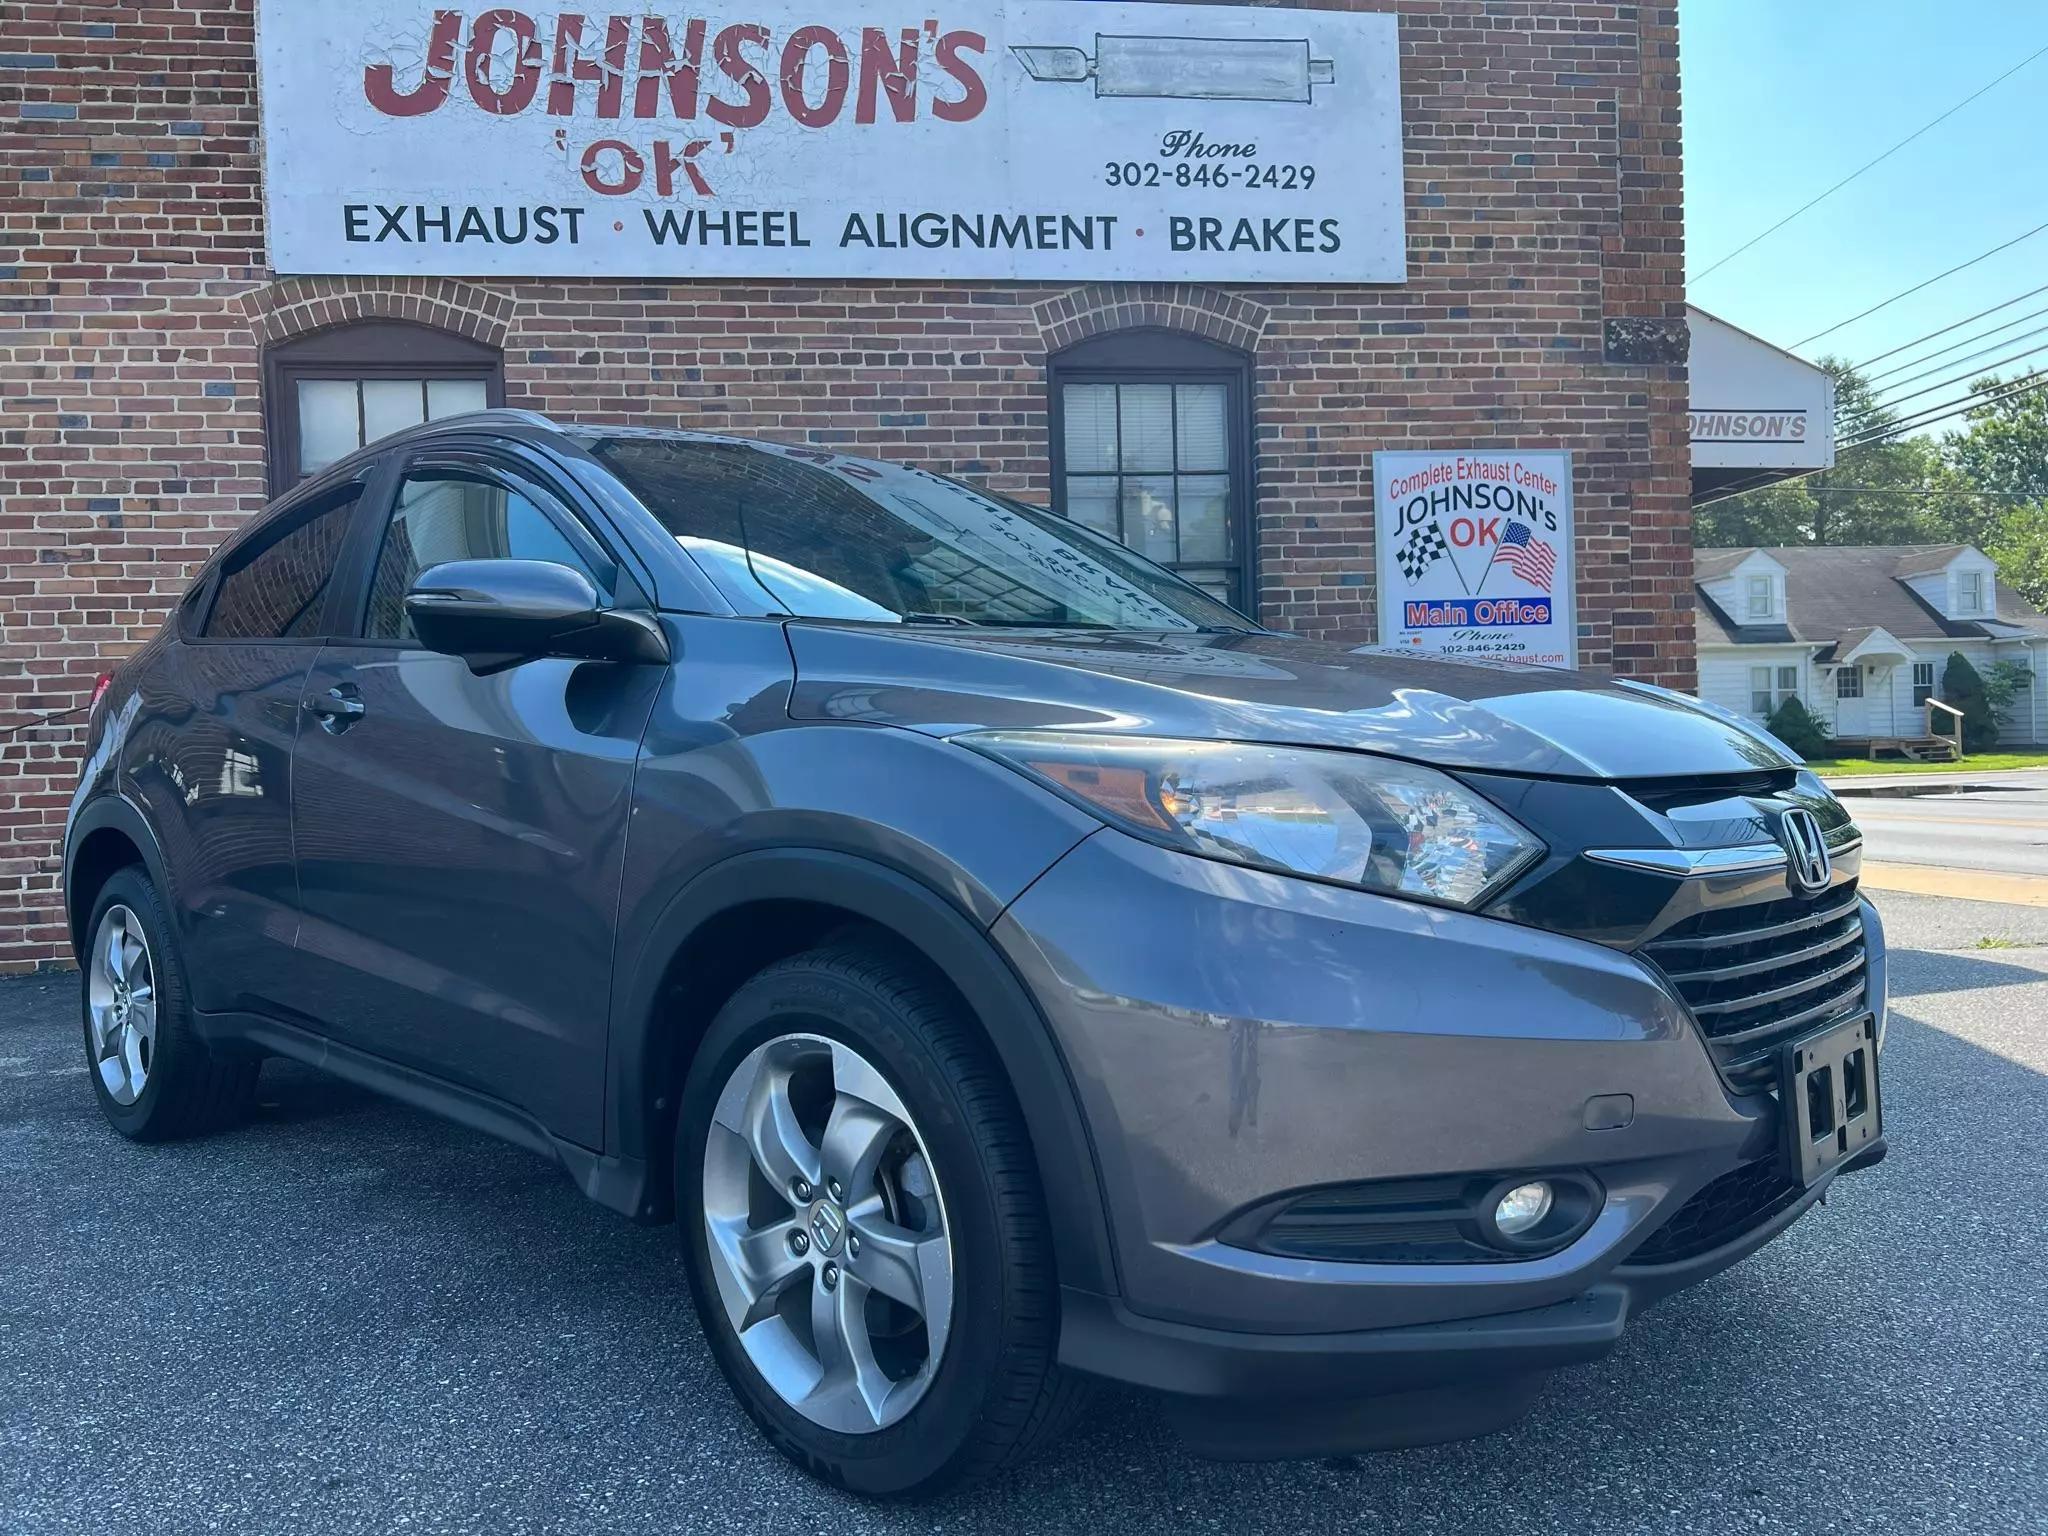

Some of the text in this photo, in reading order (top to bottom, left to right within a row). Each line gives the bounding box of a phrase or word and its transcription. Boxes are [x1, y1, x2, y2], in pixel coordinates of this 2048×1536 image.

[364, 8, 988, 128] JOHNSON'S
[1159, 129, 1257, 160] Phone
[1104, 161, 1316, 190] 302-846-2429
[343, 204, 1341, 254] EXHAUST WHEEL ALIGNMENT BRAKES
[1390, 457, 1558, 500] Complete Exhaust Center
[1449, 516, 1501, 548] OK
[1406, 600, 1549, 627] Main Office
[1449, 629, 1514, 641] Phone
